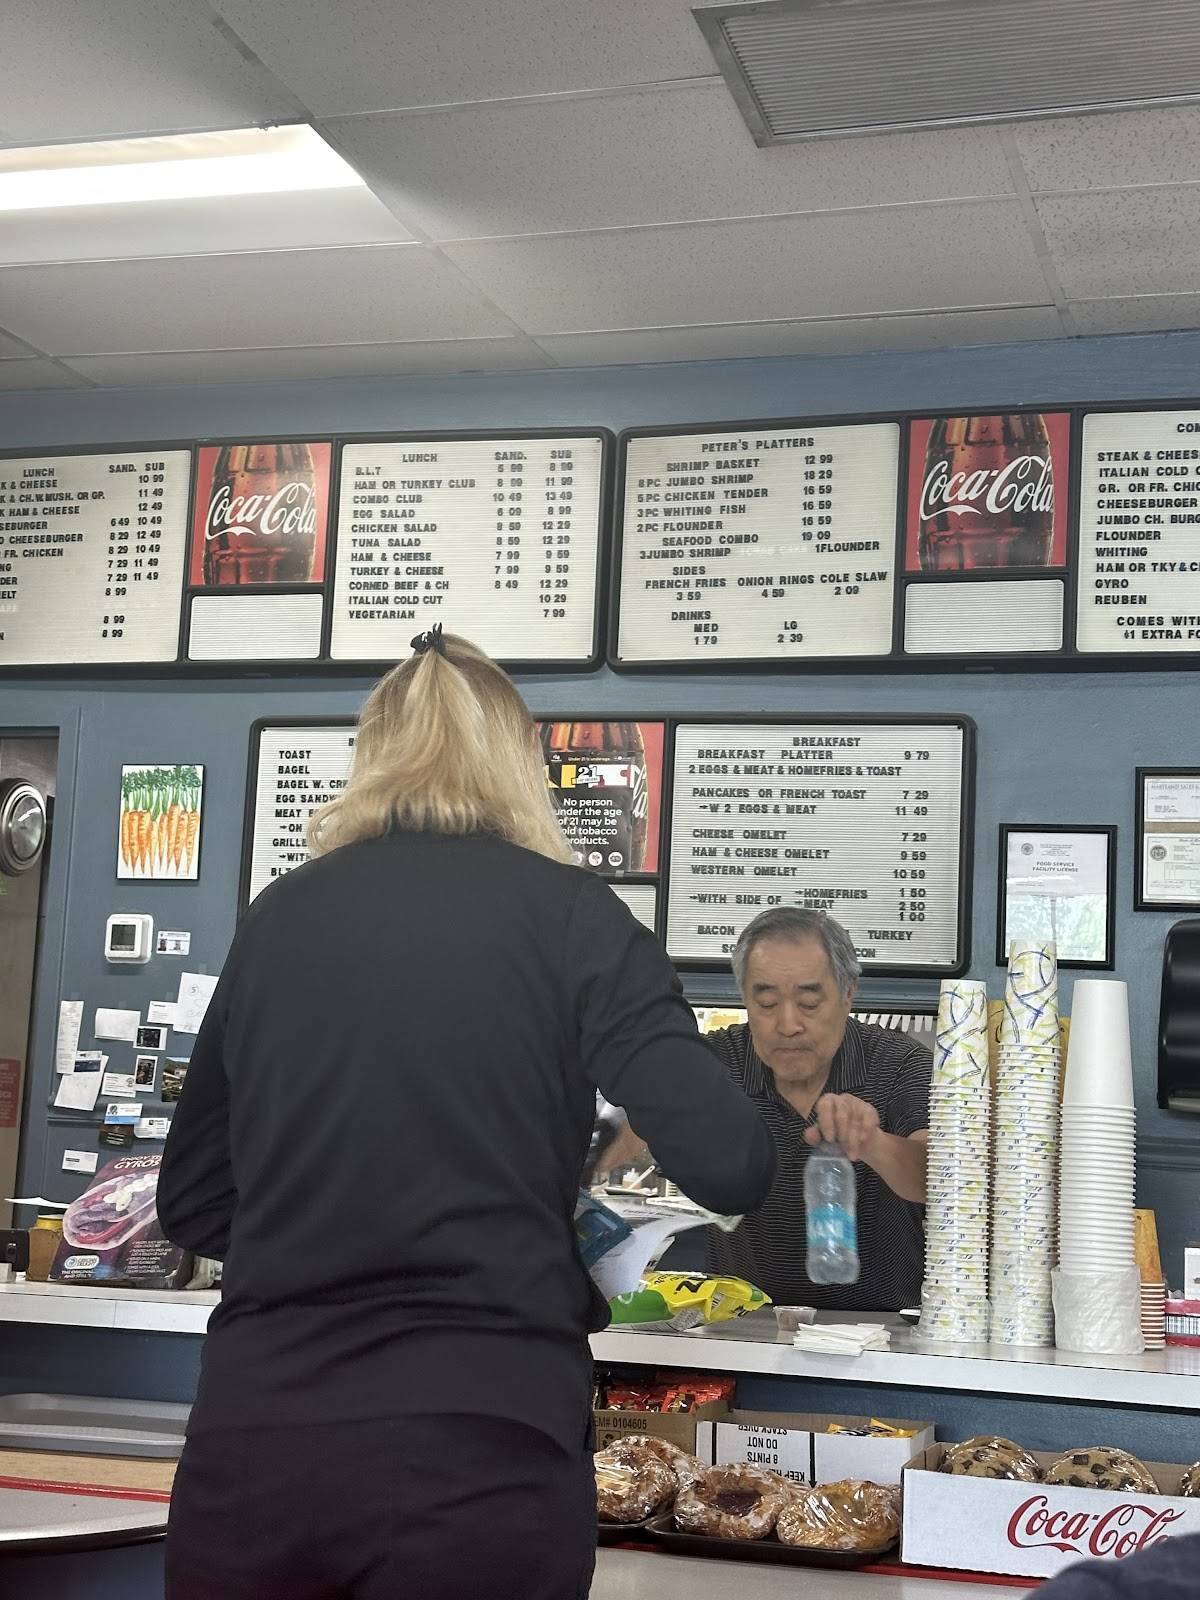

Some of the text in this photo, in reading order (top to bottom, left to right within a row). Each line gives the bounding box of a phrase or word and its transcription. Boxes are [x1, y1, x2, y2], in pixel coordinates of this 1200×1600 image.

[702, 437, 814, 452] PETER'S PLATTERS
[402, 450, 572, 463] LUNCH SAND. SUB
[1098, 450, 1200, 462] STEAK CHEES
[23, 462, 165, 477] LUNCH SAND. SUB
[667, 458, 760, 472] SHRIMP BASKET
[1099, 467, 1149, 477] ITALIAN
[1156, 466, 1189, 476] COLD
[20, 479, 57, 489] CHEESE
[354, 479, 475, 490] HAM OR TURKEY CLUB
[666, 474, 754, 487] JUMBO SHRIMP
[920, 455, 1055, 520] Coca-Cola
[1128, 483, 1145, 493] OR
[1149, 482, 1168, 492] FR.
[353, 494, 422, 504] COMBO CLUB
[664, 488, 768, 501] CHICKEN TENDER
[1097, 498, 1198, 509] CHEESEBURGER
[9, 508, 29, 517] HAM
[42, 506, 80, 515] CHEESE
[205, 482, 317, 540] Coca-Cola
[353, 509, 415, 519] EGG SALAD
[663, 504, 746, 516] WHITING FISH
[1097, 514, 1164, 525] JUMBO CH.
[351, 523, 437, 533] CHICKEN SALAD
[663, 521, 723, 532] FLOUNDER
[9, 533, 83, 544] CHEESEBURGER
[662, 534, 759, 546] SEAFOOD COMBO
[1096, 531, 1161, 541] FLOUNDER
[351, 538, 421, 547] TUNA SALAD
[22, 548, 63, 558] CHICKEN
[351, 552, 432, 562] HAM CHEESE
[689, 548, 731, 558] SHRIMP
[1095, 547, 1148, 557] WHITING
[350, 566, 444, 576] TURKEY CHEESE
[672, 566, 706, 576] SIDES
[1096, 562, 1146, 572] HAM OR
[349, 581, 449, 590] CORNED BEEF CH
[645, 571, 888, 589] FRENCH FRIES ONION RINGS COLE SLAW
[1095, 579, 1129, 589] GYRO
[348, 596, 443, 605] ITALIAN COLD CUT
[1095, 595, 1147, 605] REUBEN
[349, 610, 415, 619] VEGETARIAN
[671, 610, 711, 621] DRINKS
[1116, 616, 1164, 626] COMES
[694, 621, 798, 633] MED LG
[1142, 629, 1182, 639] EXTRA
[792, 737, 861, 747] BREAKFAST
[279, 750, 311, 759] TOAST
[697, 749, 833, 760] BREAKFAST PLATTER
[278, 765, 310, 774] BAGEL
[578, 766, 599, 779] 21
[698, 764, 902, 776] EGGS MEAT HOMEFRIES TOAST
[277, 780, 309, 789] BAGEL
[275, 794, 296, 803] EGG
[692, 787, 867, 799] PANCAKES OR FRENCH TOAST
[564, 798, 613, 808] No person
[275, 809, 302, 818] MEAT
[585, 808, 601, 816] the
[603, 809, 622, 818] age
[738, 804, 817, 814] EGGS MEAT
[288, 823, 302, 832] ON
[558, 817, 568, 825] of
[581, 819, 602, 828] may
[604, 818, 617, 826] be
[561, 827, 618, 835] old tobacco
[692, 829, 787, 840] CHEESE OMELET
[568, 837, 609, 845] roducts.
[692, 847, 830, 859] HAM CHEESE OMELET
[691, 865, 798, 876] WESTERN OMELET
[697, 893, 782, 905] WITH SIDE OF
[803, 888, 868, 899] HOMEFRIES
[803, 899, 835, 909] MEAT
[697, 925, 913, 940] BACON TURKEY
[114, 1160, 160, 1169] GYROS
[613, 1418, 647, 1429] 0104605
[747, 1436, 778, 1449] DO NOT
[747, 1452, 778, 1464] 8 PINTS
[1007, 1495, 1187, 1560] Coca-Col
